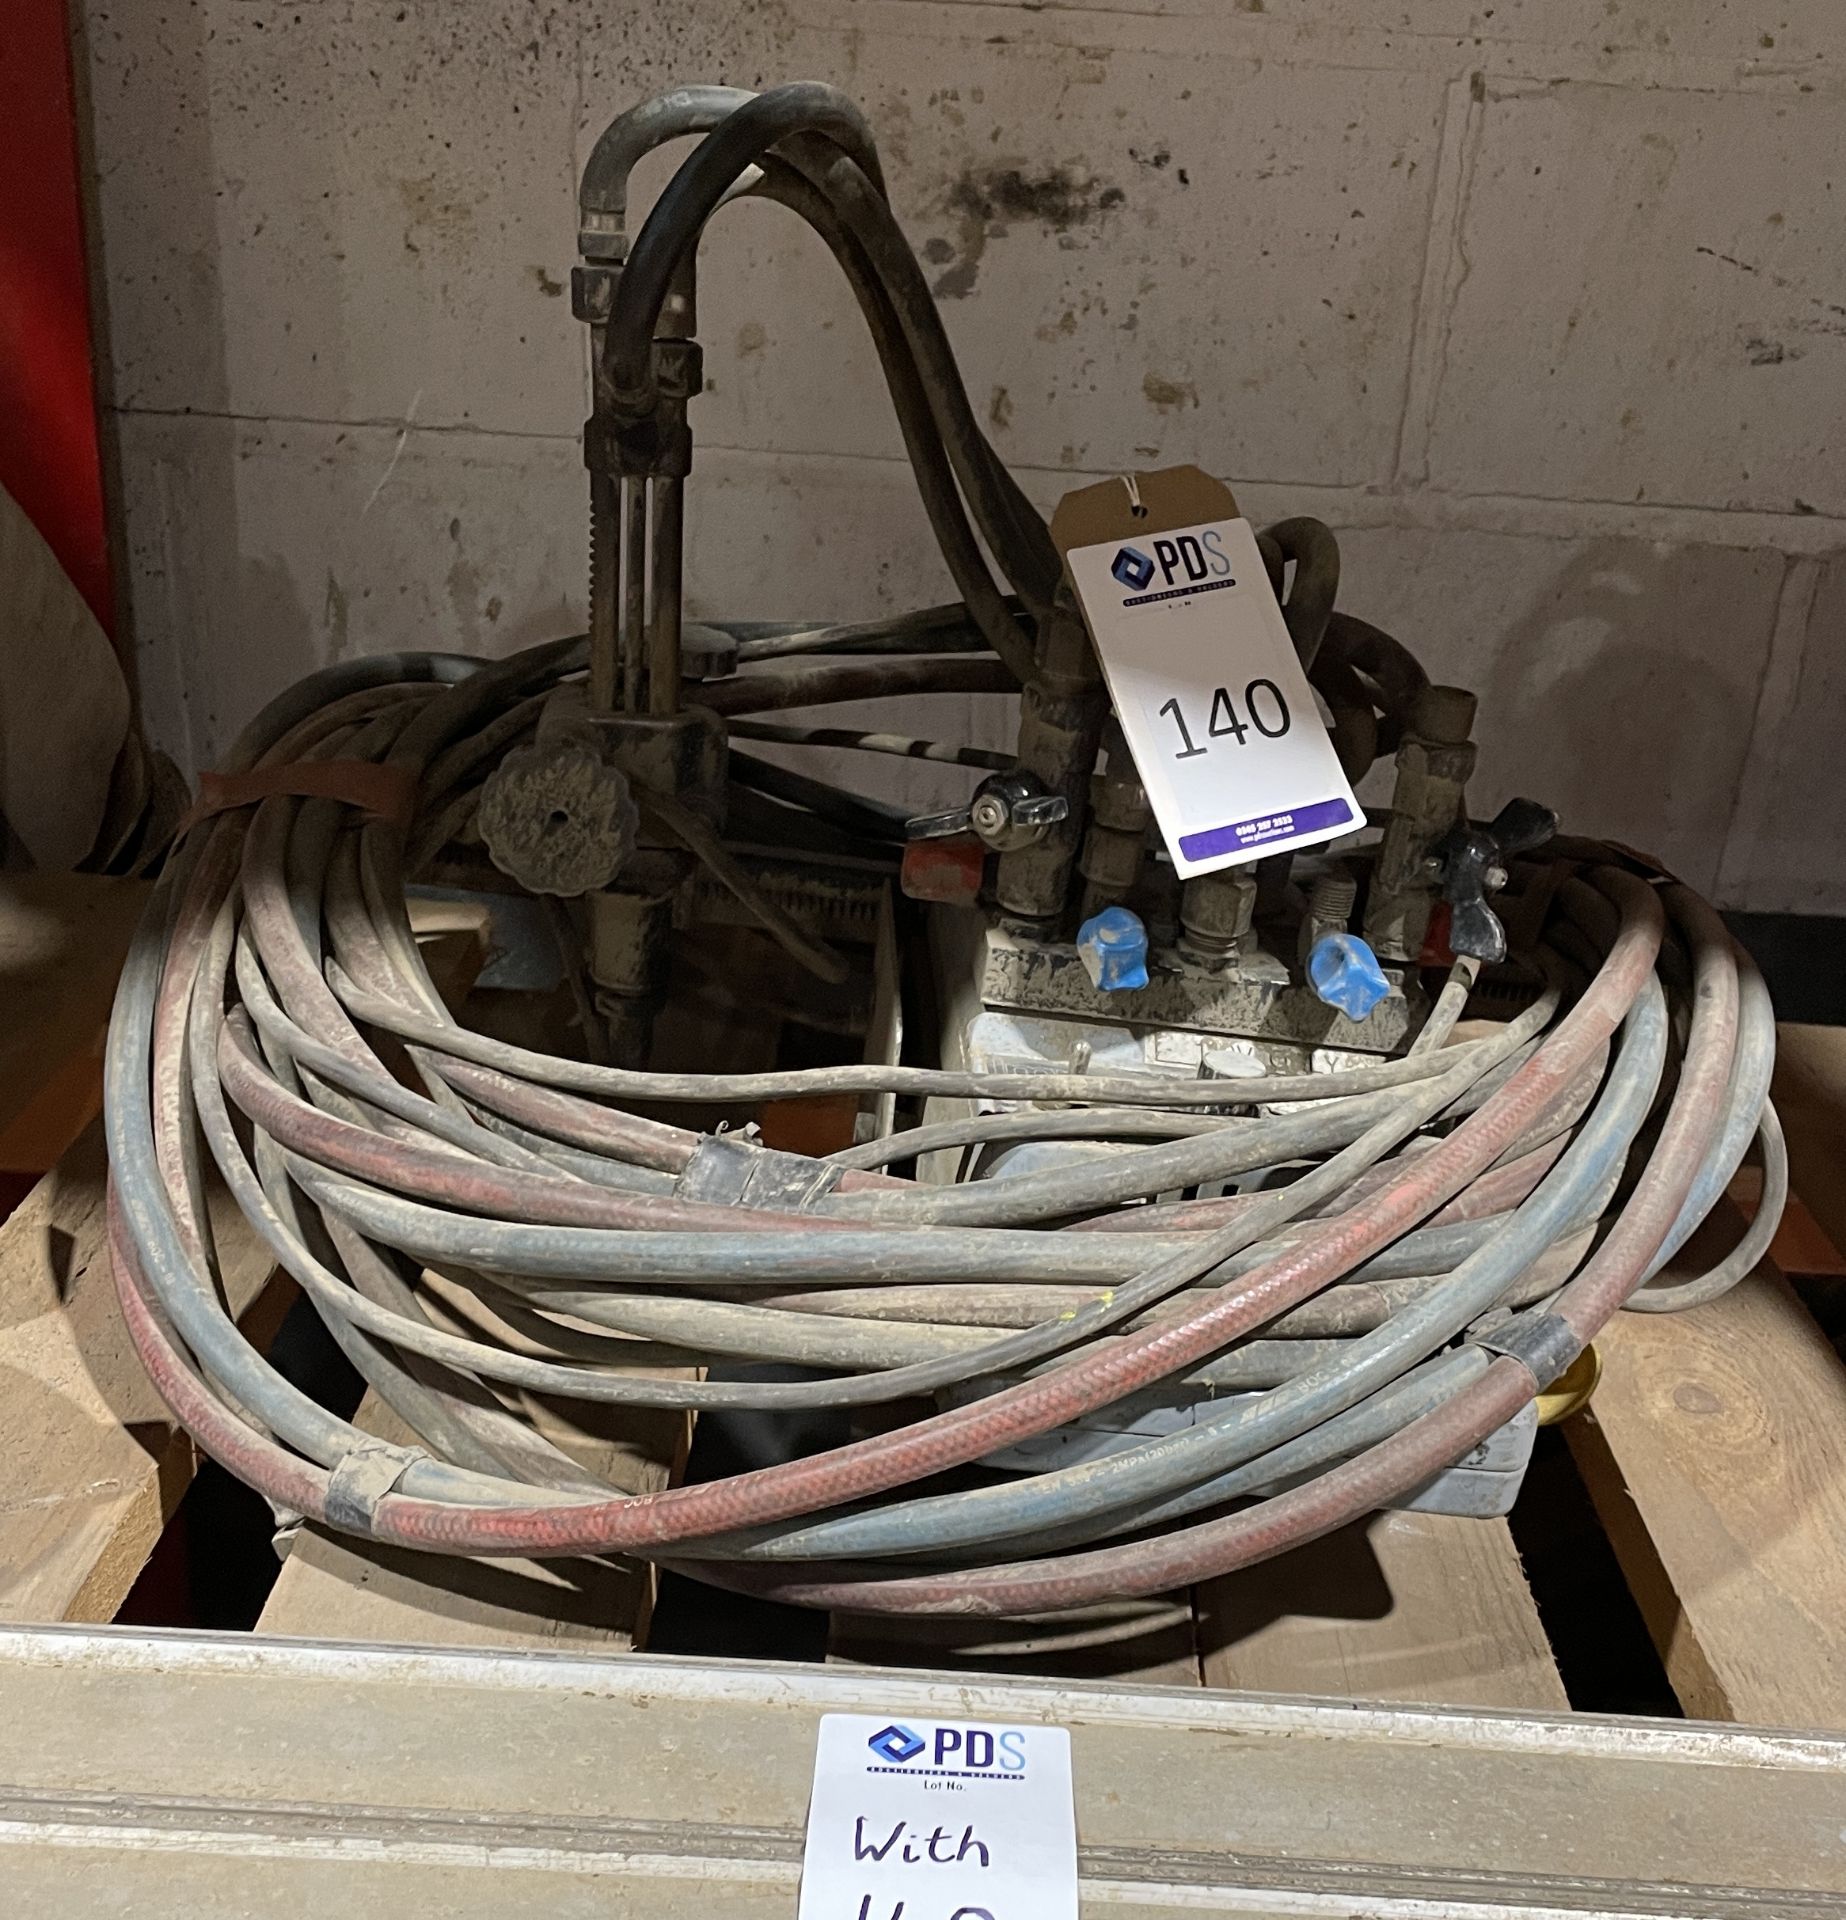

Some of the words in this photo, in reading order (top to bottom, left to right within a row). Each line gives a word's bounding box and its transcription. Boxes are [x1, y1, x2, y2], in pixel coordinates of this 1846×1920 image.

[1153, 531, 1230, 585] PDS
[1160, 679, 1291, 759] 140
[934, 1728, 1026, 1771] PDS
[923, 1779, 942, 1790] Lot
[854, 1815, 989, 1867] With
